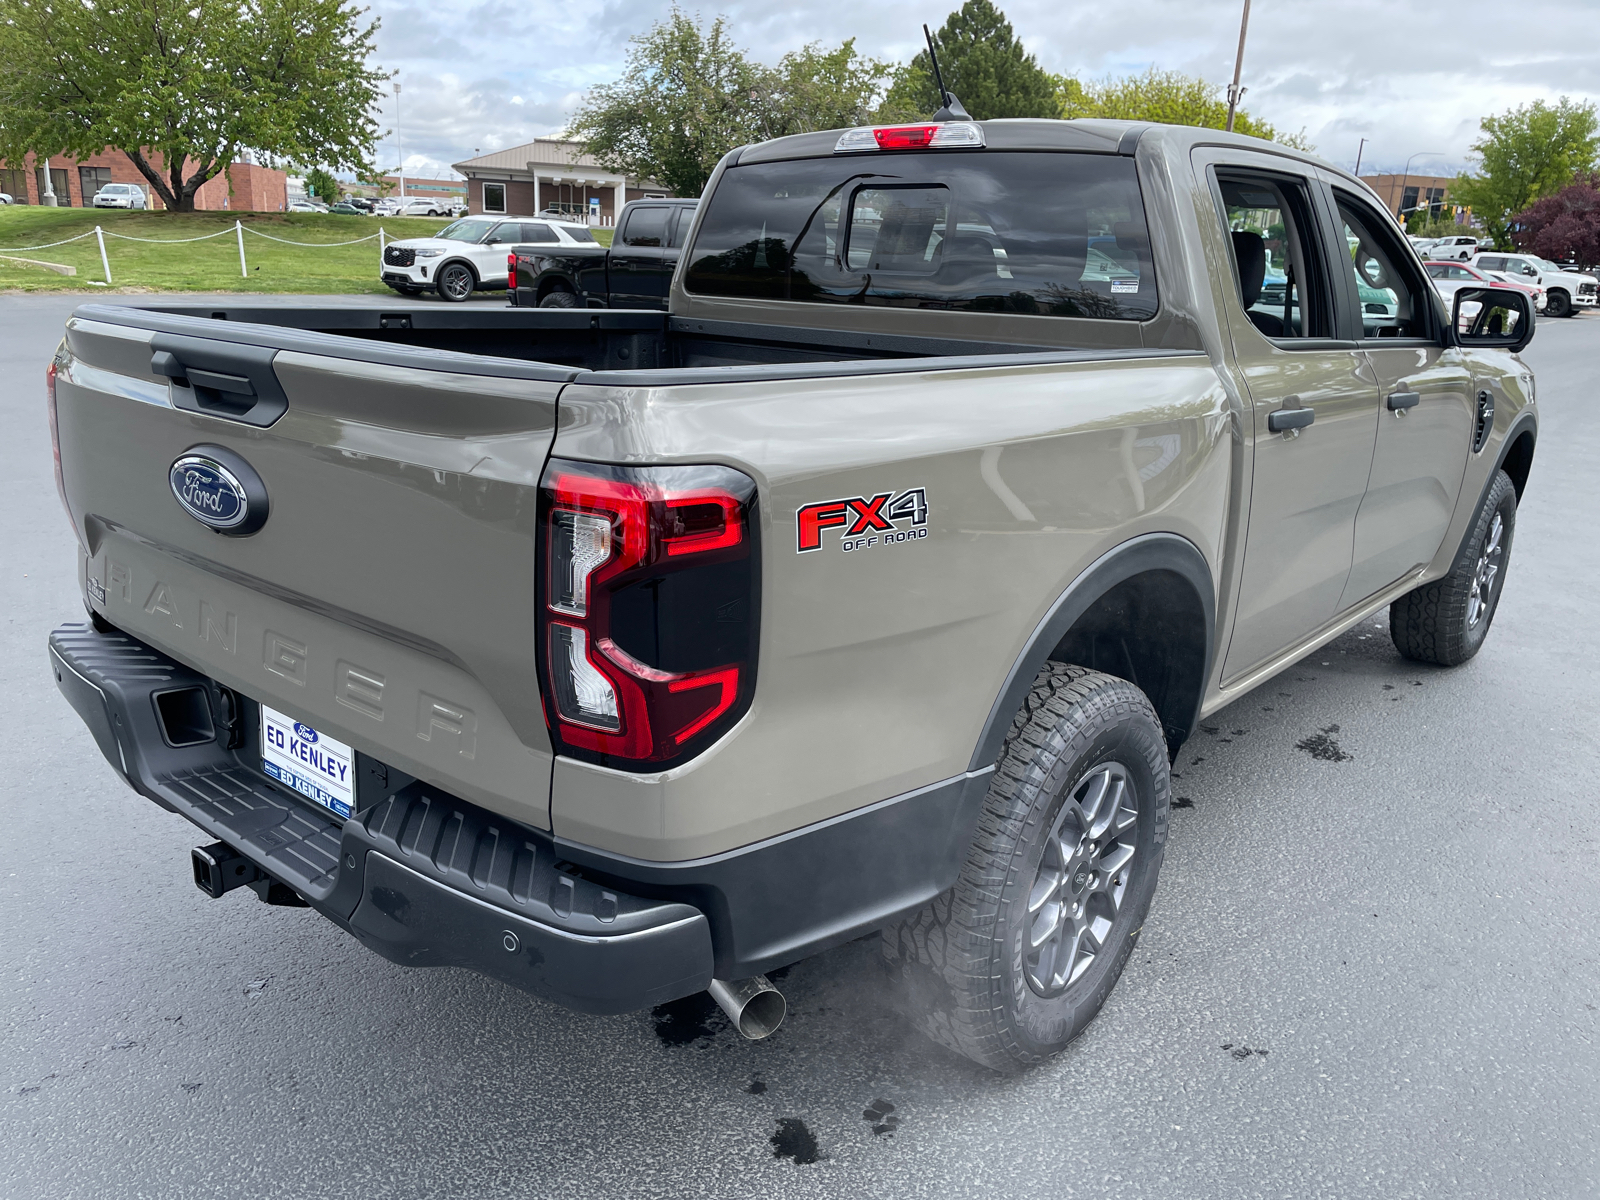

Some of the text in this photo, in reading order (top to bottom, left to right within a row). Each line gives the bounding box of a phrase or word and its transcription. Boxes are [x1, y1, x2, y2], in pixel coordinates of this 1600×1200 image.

[183, 470, 223, 512] Ford
[796, 487, 928, 554] FX4
[842, 528, 928, 552] OFF ROAD
[104, 555, 477, 759] RANGER
[267, 724, 347, 782] ED KENLEY
[298, 724, 315, 742] Ford
[280, 769, 294, 785] ED
[295, 777, 333, 810] KENLEY
